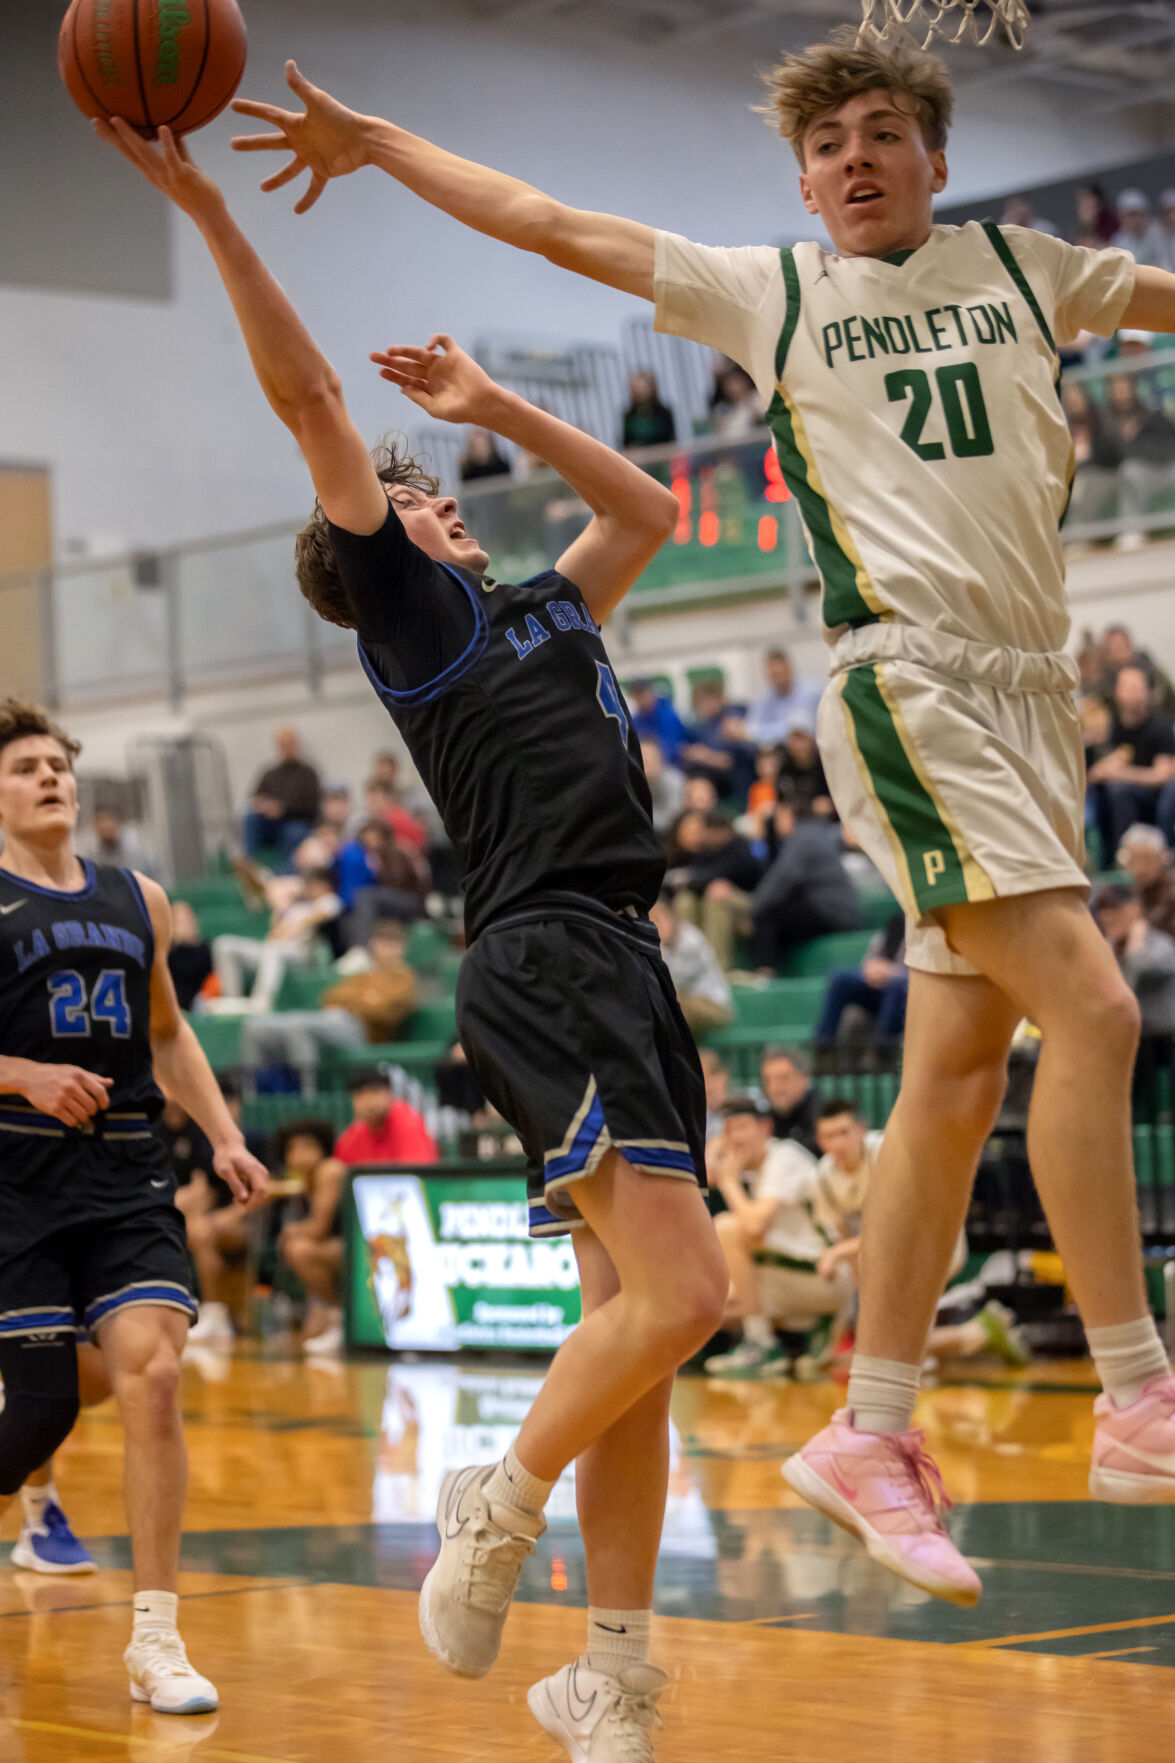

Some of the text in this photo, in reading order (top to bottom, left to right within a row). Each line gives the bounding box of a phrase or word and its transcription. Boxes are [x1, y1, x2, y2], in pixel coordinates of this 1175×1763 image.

[158, 0, 191, 84] ilson
[822, 301, 1018, 368] PENDLETON
[884, 361, 994, 462] 20
[505, 600, 601, 660] LA GRA
[922, 849, 946, 886] P
[13, 928, 51, 974] LA
[47, 969, 132, 1039] 24
